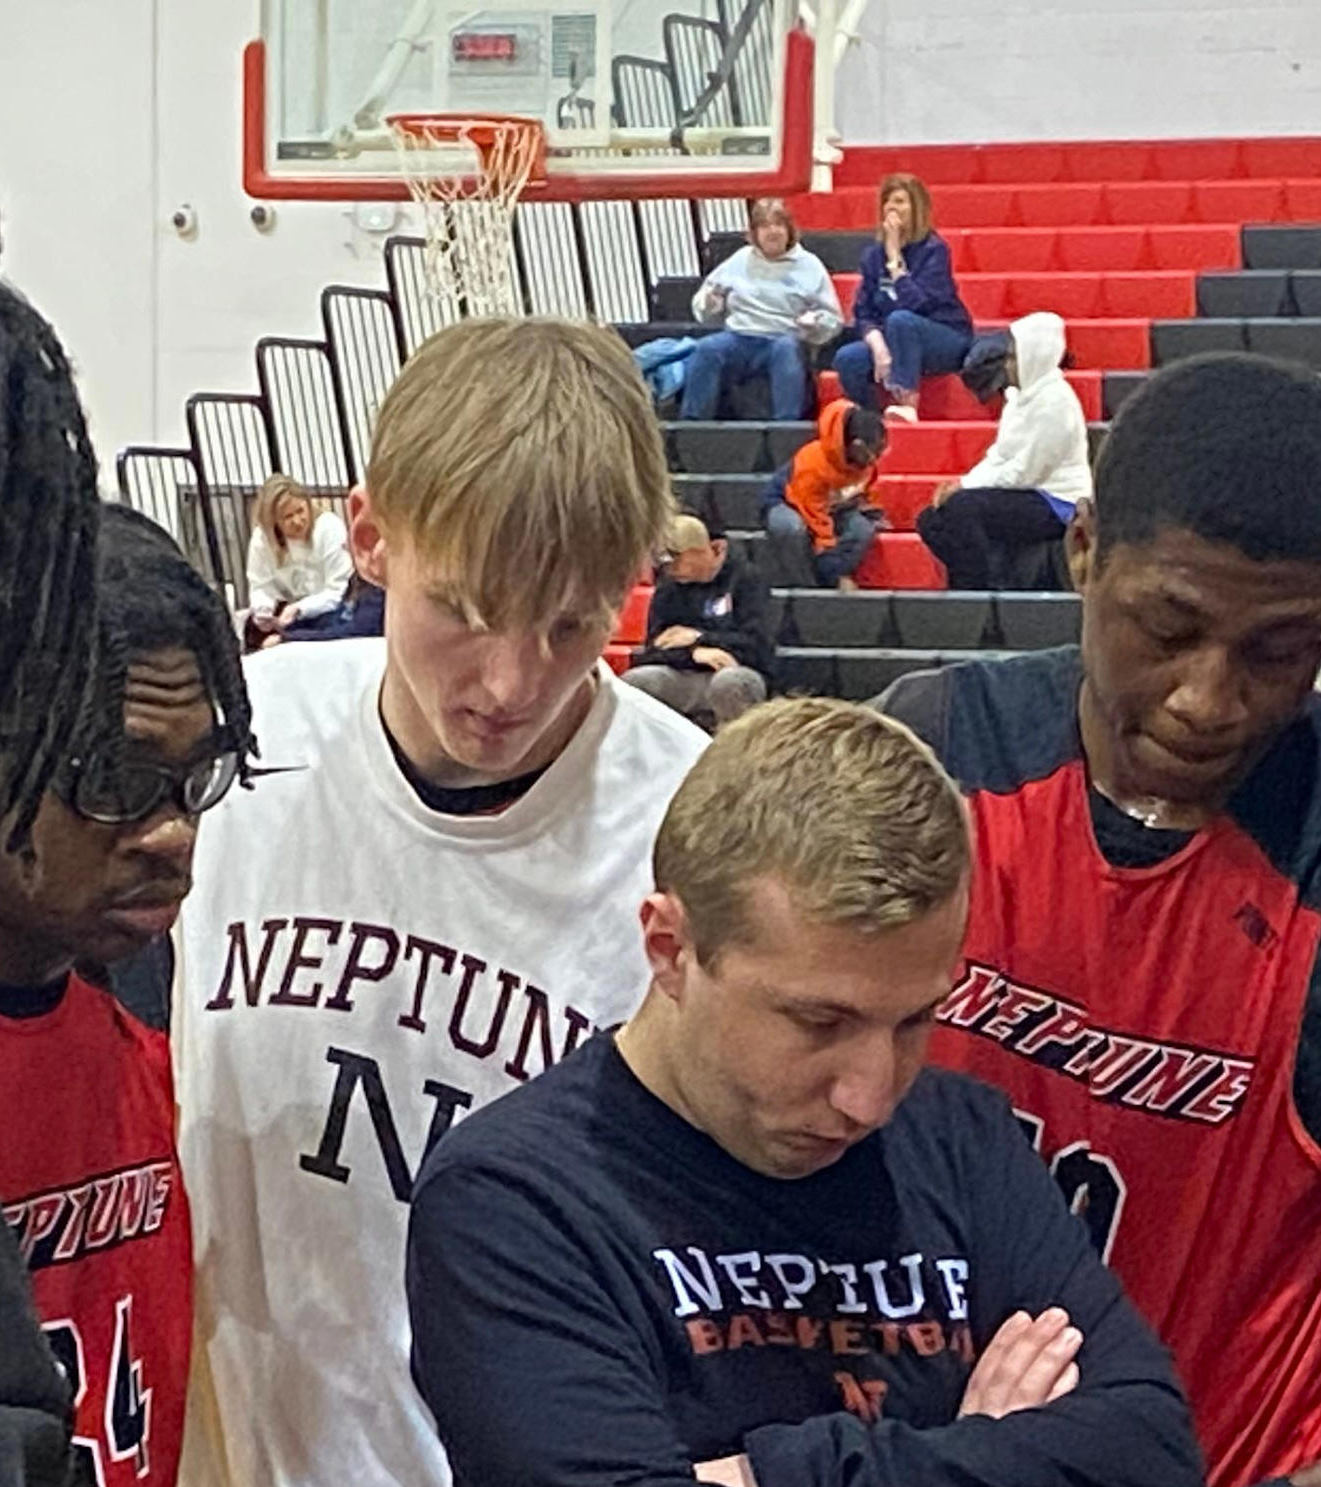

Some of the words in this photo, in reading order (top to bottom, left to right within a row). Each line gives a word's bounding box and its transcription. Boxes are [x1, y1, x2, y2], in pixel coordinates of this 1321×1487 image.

[205, 916, 603, 1083] NEPTUN
[935, 965, 1256, 1123] NEPTUNE
[299, 1046, 474, 1204] N
[2, 1161, 172, 1264] PTUNE
